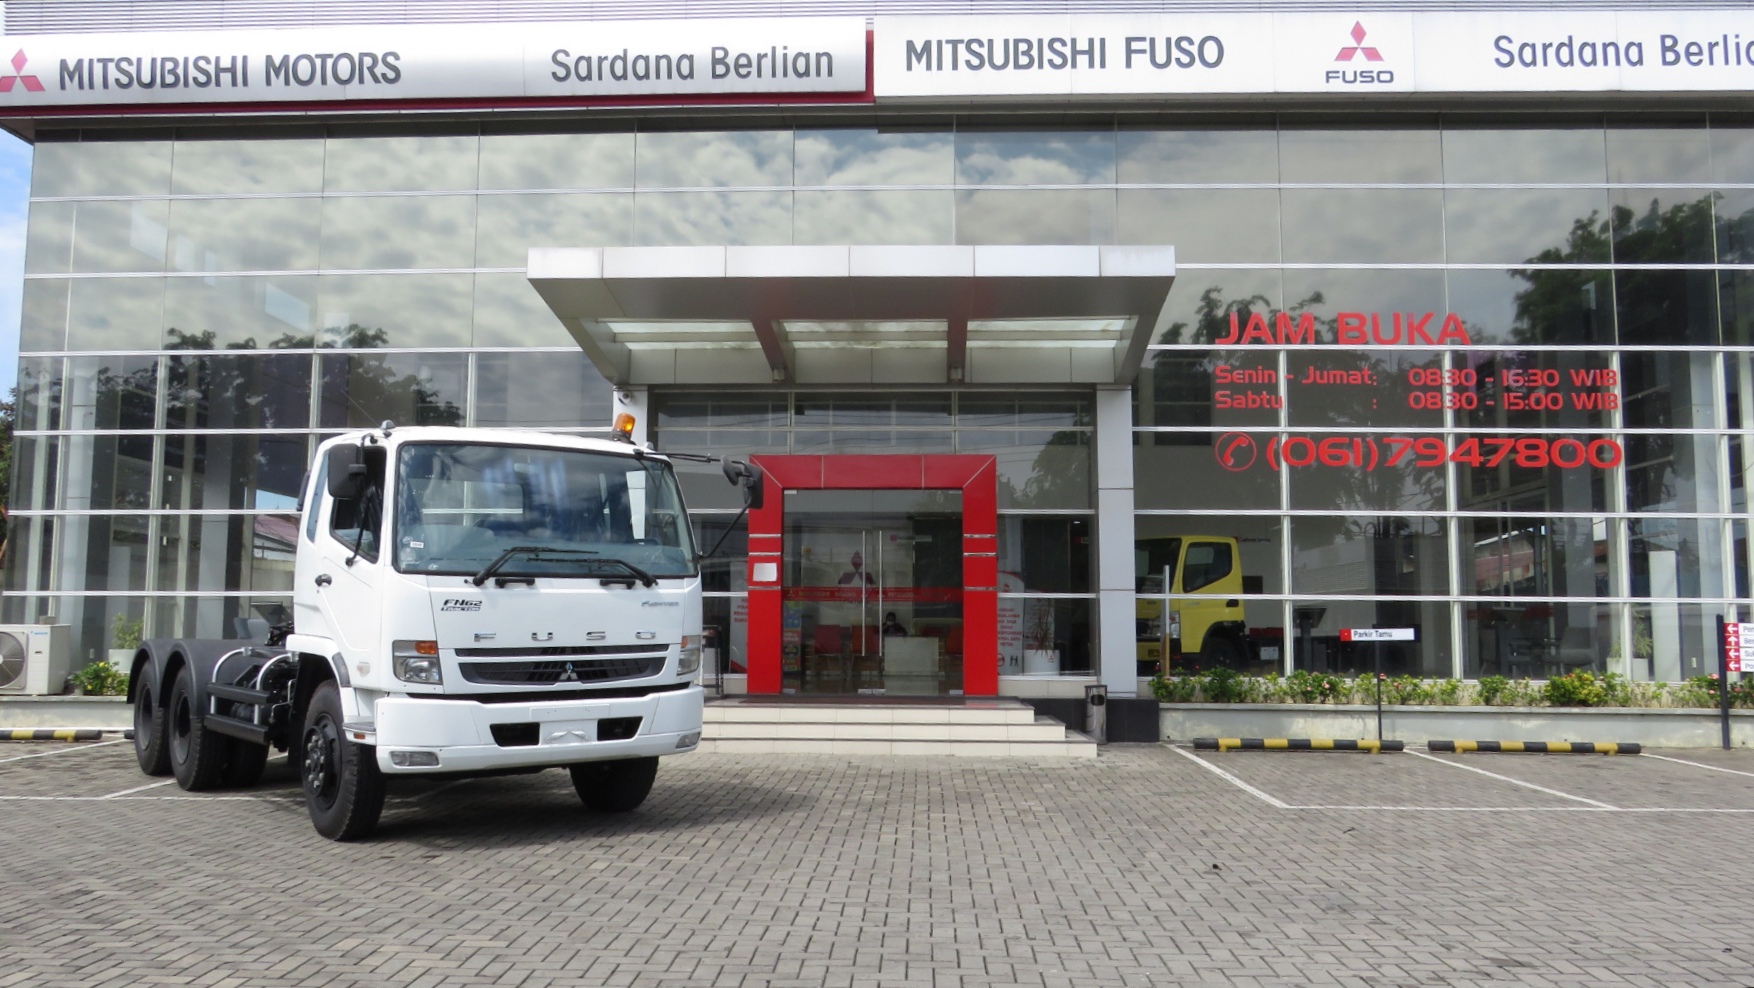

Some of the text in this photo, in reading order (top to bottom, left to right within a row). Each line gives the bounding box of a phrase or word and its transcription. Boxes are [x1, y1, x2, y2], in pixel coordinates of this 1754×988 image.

[551, 46, 833, 83] Sardana Berlian
[906, 35, 1224, 71] MITSUBISHI FUSO
[1494, 34, 1644, 68] Sardana
[59, 52, 402, 90] MITSUBISHI MOTORS
[1326, 70, 1394, 84] FUSO
[1215, 312, 1471, 345] JAM BUKA
[1214, 365, 1276, 384] Senin
[1407, 368, 1478, 387] 08:30
[1501, 369, 1560, 387] 16:30
[1569, 369, 1618, 387] WIB
[1214, 390, 1283, 409] Sabtu
[1408, 391, 1478, 410] 08:30
[1502, 392, 1563, 411] 15:00
[1571, 392, 1619, 410] WIB
[474, 631, 657, 642] FUSO
